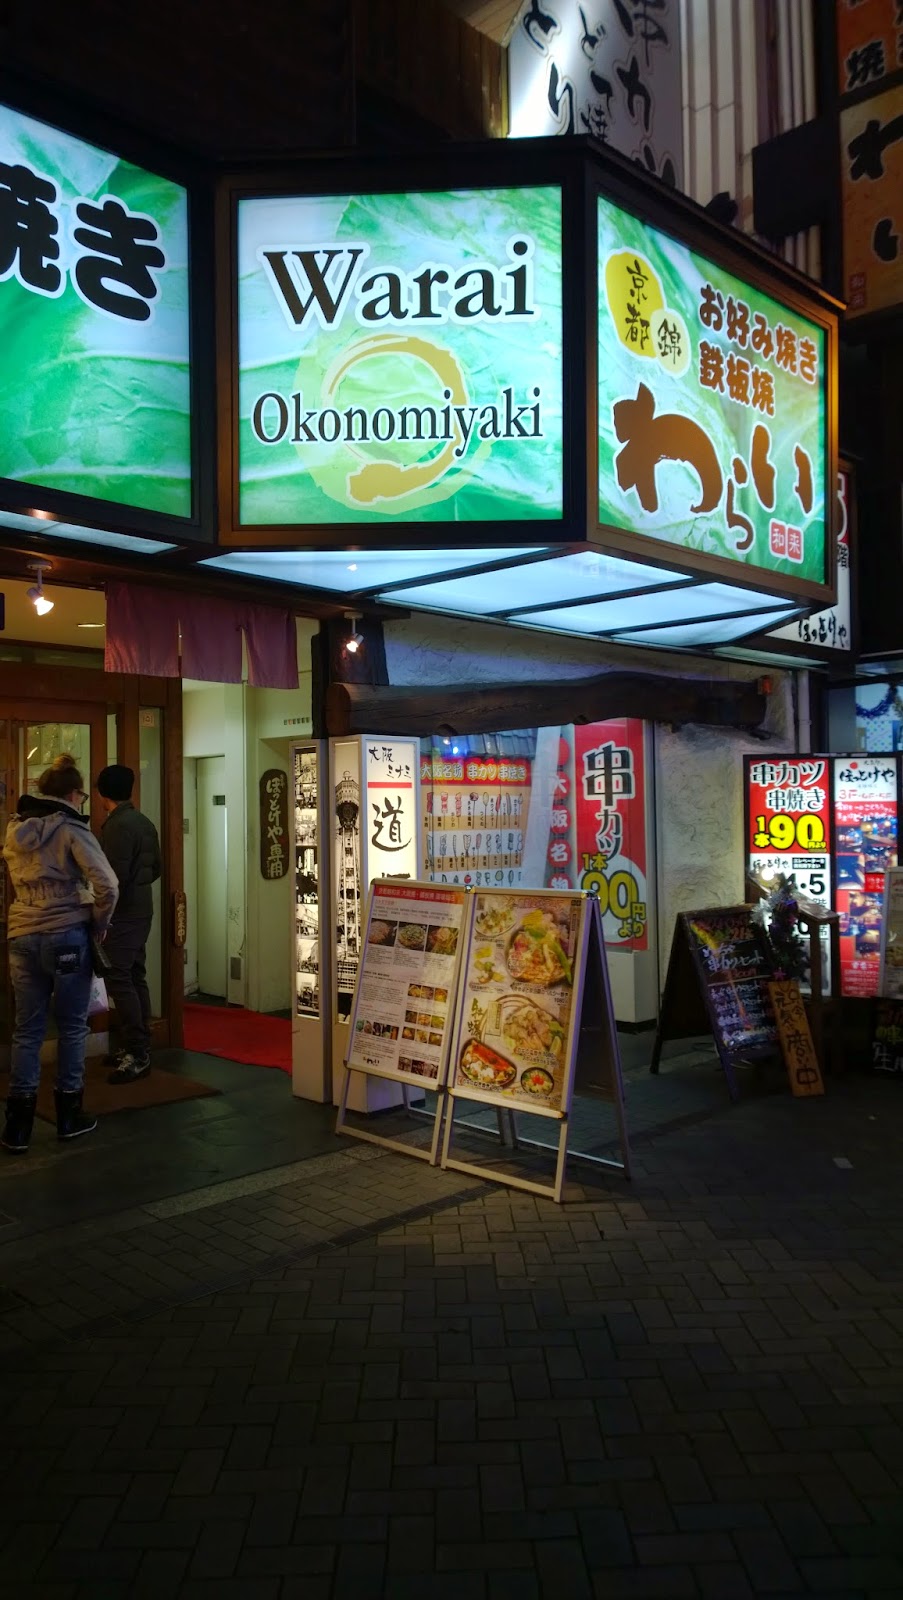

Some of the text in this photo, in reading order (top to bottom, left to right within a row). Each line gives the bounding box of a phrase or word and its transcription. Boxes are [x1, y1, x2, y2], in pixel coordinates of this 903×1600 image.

[262, 241, 534, 325] Warai
[699, 283, 818, 384] お好み焼き
[252, 387, 543, 457] Okonomiyaki
[614, 381, 812, 551] わらい
[772, 527, 801, 555] 和来
[368, 746, 394, 764] 大阪
[751, 761, 826, 786] 串カツ
[585, 744, 633, 861] 串カツ
[767, 788, 826, 812] 串焼き
[371, 795, 412, 880] 道
[754, 815, 771, 848] 1本
[768, 813, 825, 851] 90
[582, 853, 608, 872] 1本
[619, 920, 644, 938] より
